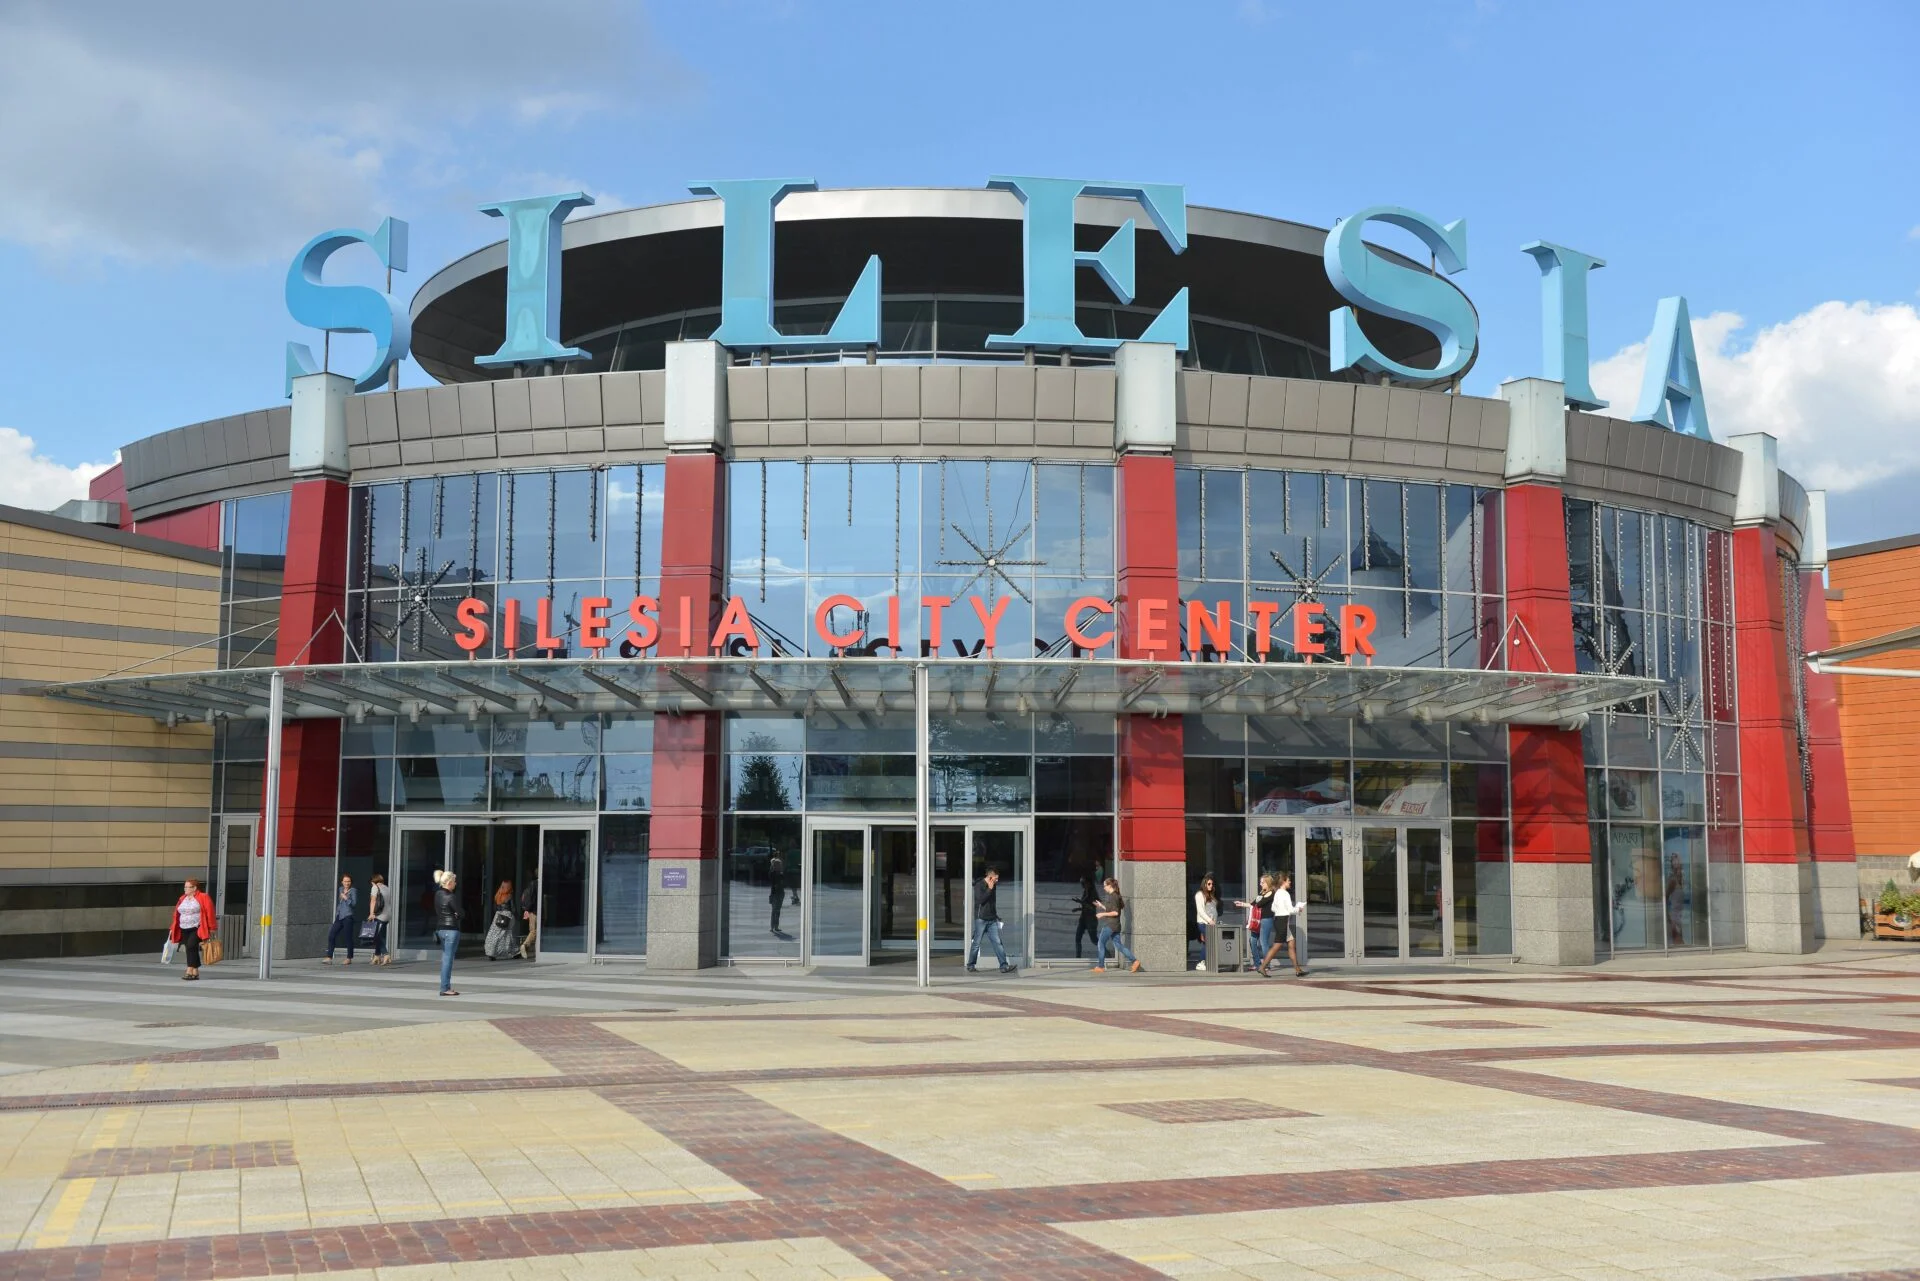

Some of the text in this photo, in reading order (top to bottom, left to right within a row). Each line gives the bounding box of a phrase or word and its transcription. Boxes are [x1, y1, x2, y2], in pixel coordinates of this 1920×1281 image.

[285, 175, 1713, 441] SILESIA
[454, 594, 761, 650] SILESIA
[814, 594, 1012, 648] CITY
[1064, 596, 1377, 656] CENTER
[1612, 831, 1641, 844] APART
